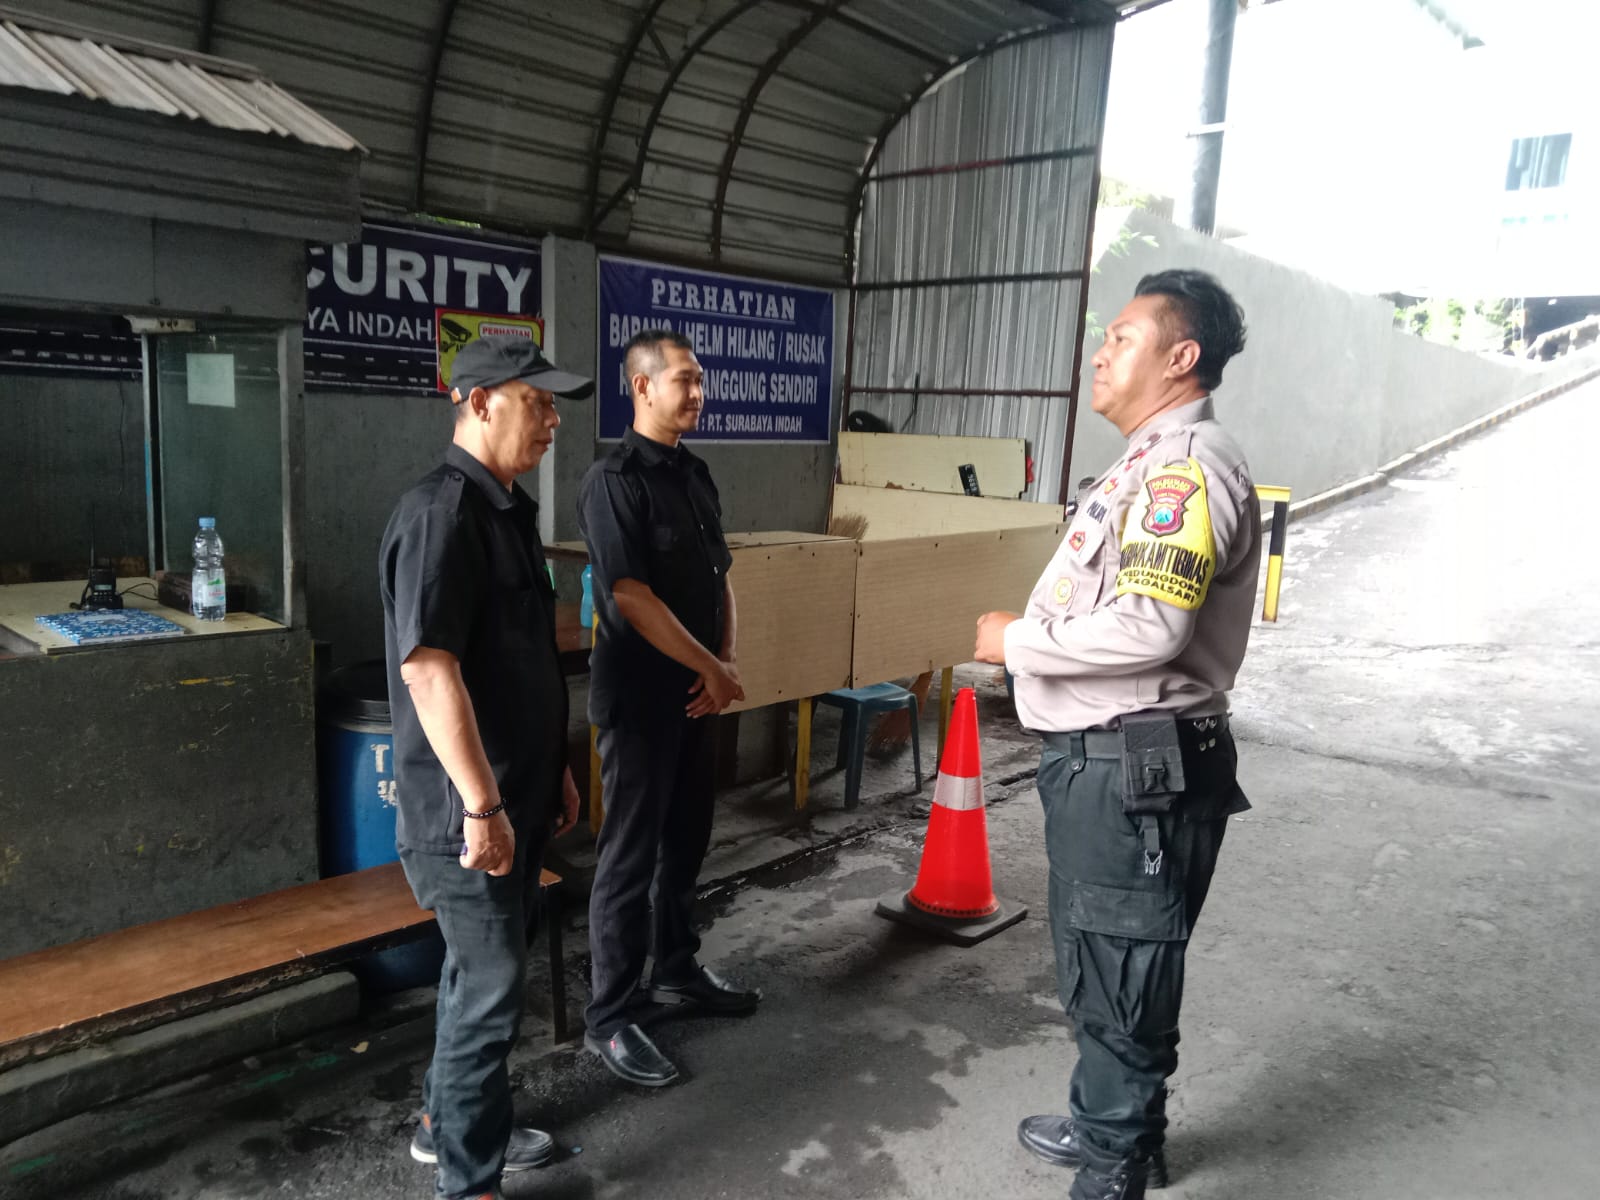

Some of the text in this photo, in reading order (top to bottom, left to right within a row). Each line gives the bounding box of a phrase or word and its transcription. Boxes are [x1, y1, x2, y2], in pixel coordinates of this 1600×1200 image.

[651, 278, 796, 321] PERHATIAN
[348, 310, 432, 342] INDAH
[685, 320, 722, 356] HELM
[727, 325, 775, 364] HILANG
[777, 332, 784, 365] /
[785, 331, 825, 365] RUSAK
[703, 369, 818, 404] ANGGUNG SENDIRI
[725, 414, 773, 433] SURABAYA
[774, 415, 802, 433] INDAH
